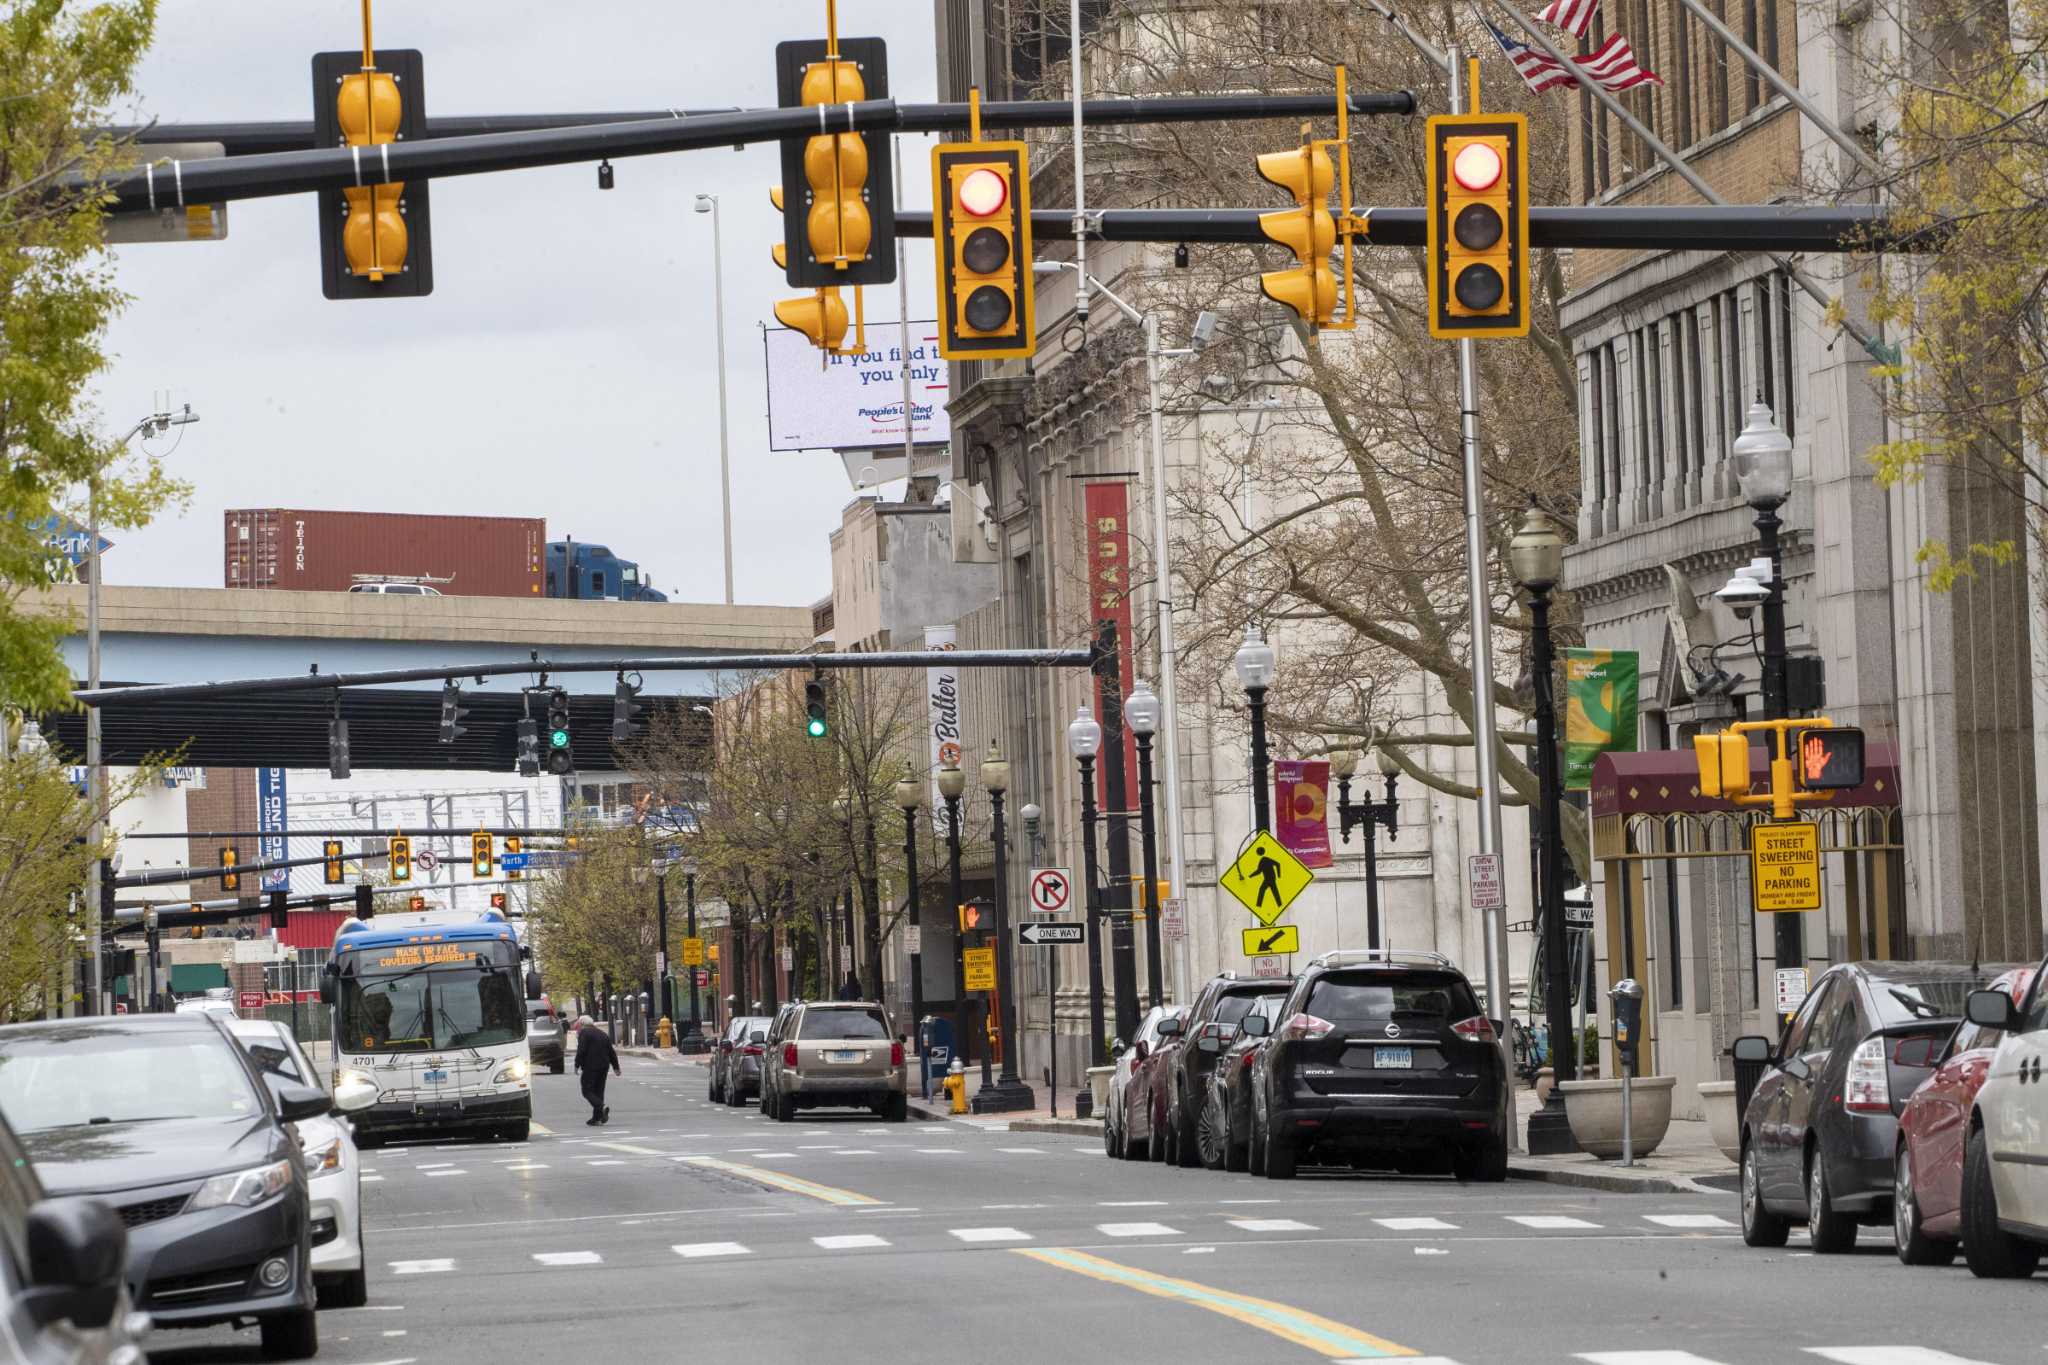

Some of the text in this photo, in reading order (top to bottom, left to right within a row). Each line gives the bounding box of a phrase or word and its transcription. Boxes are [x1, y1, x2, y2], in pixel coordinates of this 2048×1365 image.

[850, 351, 882, 367] you
[860, 364, 938, 385] you nly
[858, 406, 898, 418] People's
[296, 520, 304, 570] TRITON
[272, 796, 282, 860] SOUND
[1766, 838, 1805, 850] STREET
[502, 856, 522, 865] North
[1760, 850, 1814, 862] SWEEPING
[1780, 866, 1794, 876] NO
[1765, 877, 1810, 890] PARKING
[1040, 929, 1077, 938] ONE WAY
[396, 946, 419, 958] MASK
[435, 944, 458, 954] FACE
[380, 956, 422, 967] COVERING
[424, 952, 465, 964] REQUIRED
[1256, 968, 1280, 976] PARKING
[352, 1057, 375, 1066] 4701
